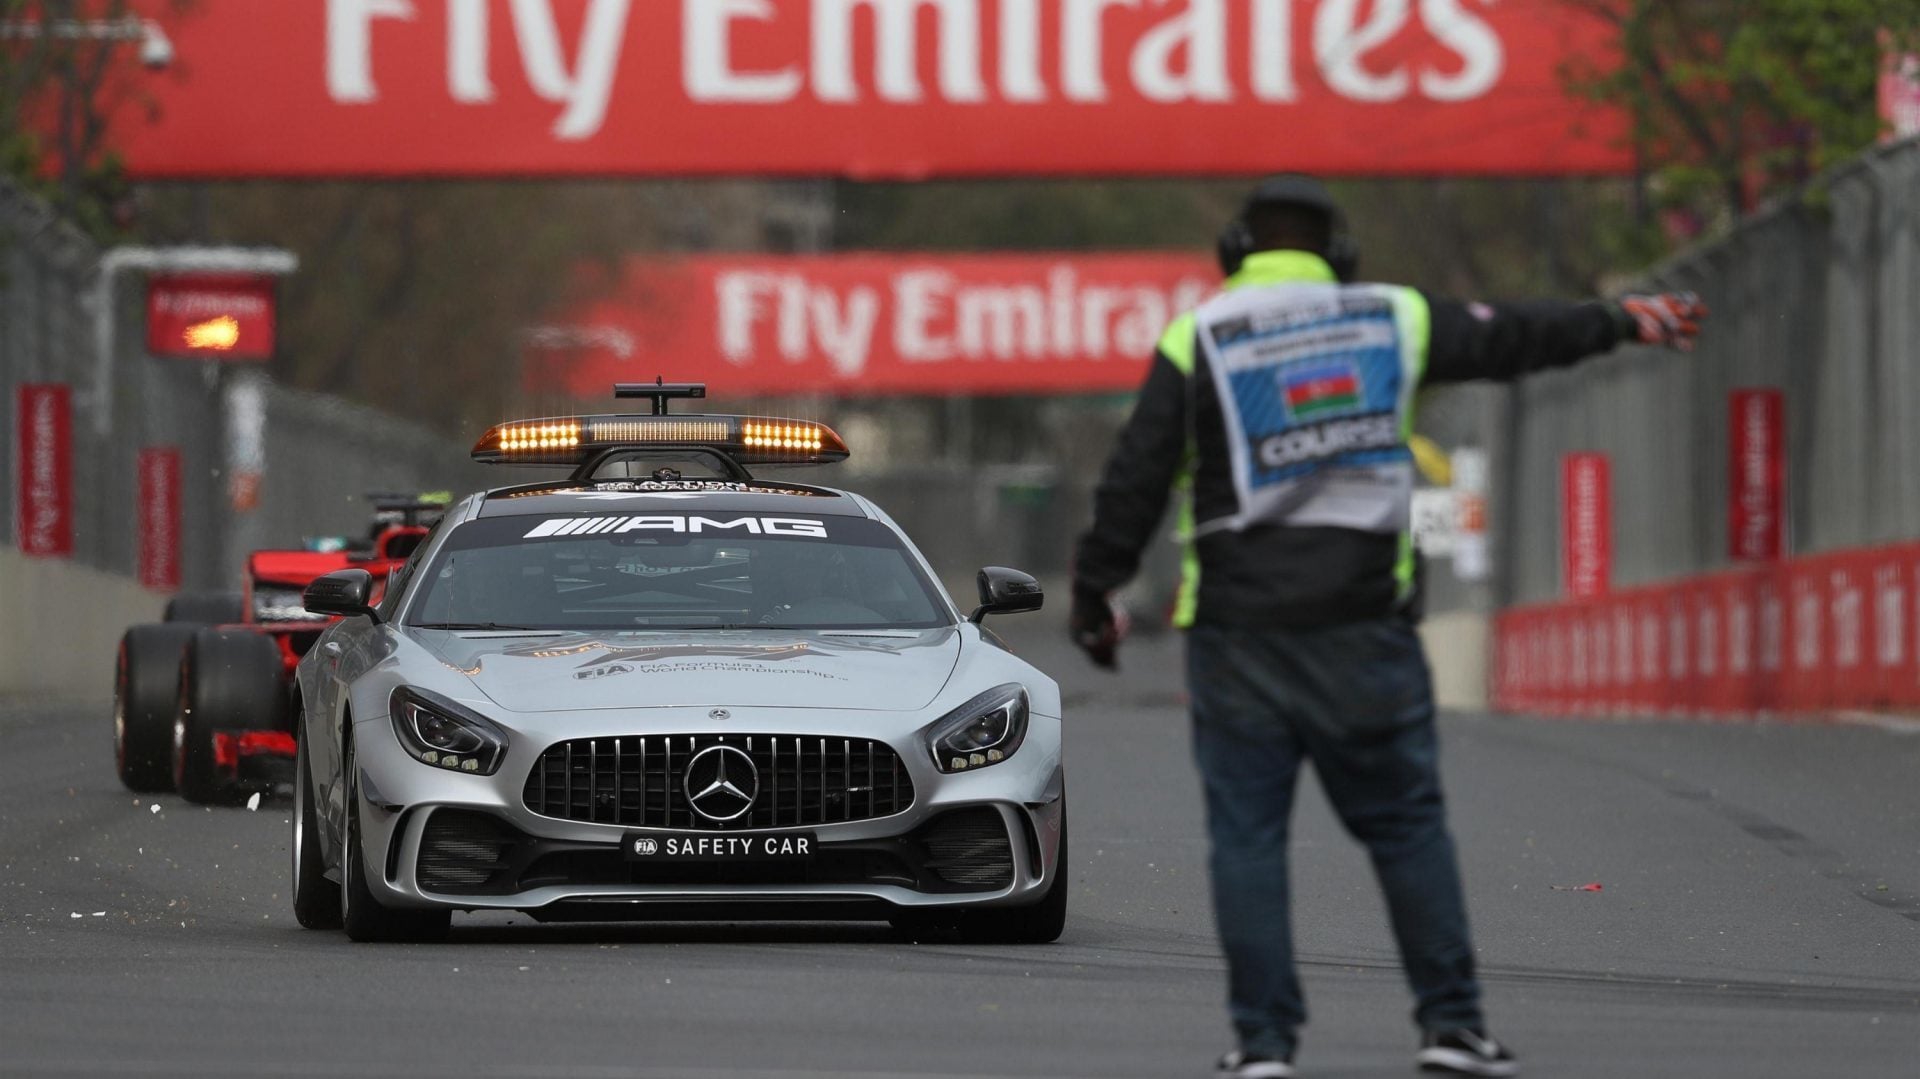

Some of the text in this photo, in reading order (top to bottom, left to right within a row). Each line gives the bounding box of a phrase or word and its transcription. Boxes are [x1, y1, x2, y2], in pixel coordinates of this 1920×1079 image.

[325, 0, 1505, 139] Fly Emirates
[715, 268, 876, 376] Fly
[1260, 414, 1397, 466] COURSE
[613, 515, 828, 538] AMG
[577, 664, 629, 680] FIA
[641, 665, 835, 679] World Championship
[635, 838, 809, 855] FIA SAFETY CAR
